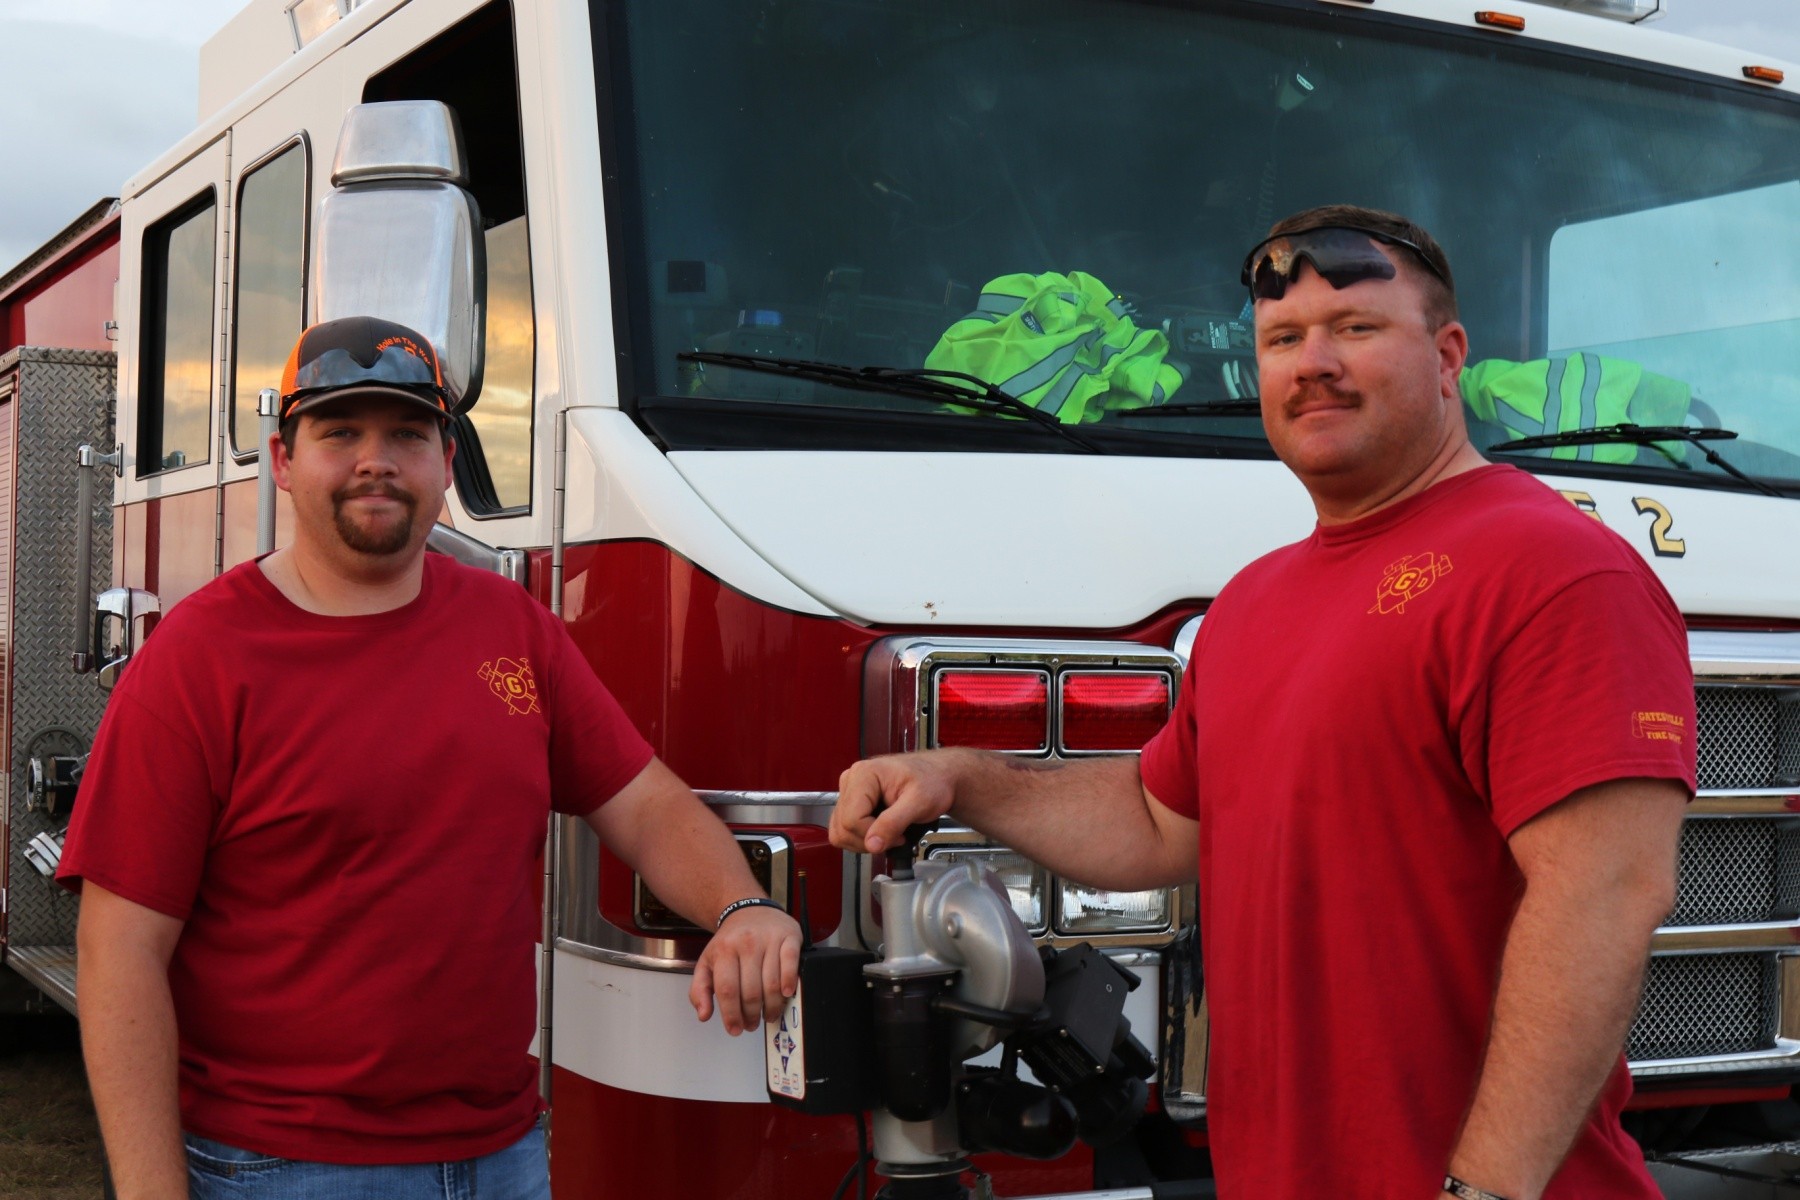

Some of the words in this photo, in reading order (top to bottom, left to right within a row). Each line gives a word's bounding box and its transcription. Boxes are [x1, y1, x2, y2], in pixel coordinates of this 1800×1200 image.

[401, 336, 417, 349] The
[1394, 572, 1417, 590] G
[506, 676, 522, 693] G
[1638, 711, 1684, 727] GATESVILLE
[1646, 731, 1668, 740] FIRE
[739, 898, 760, 906] BLUE
